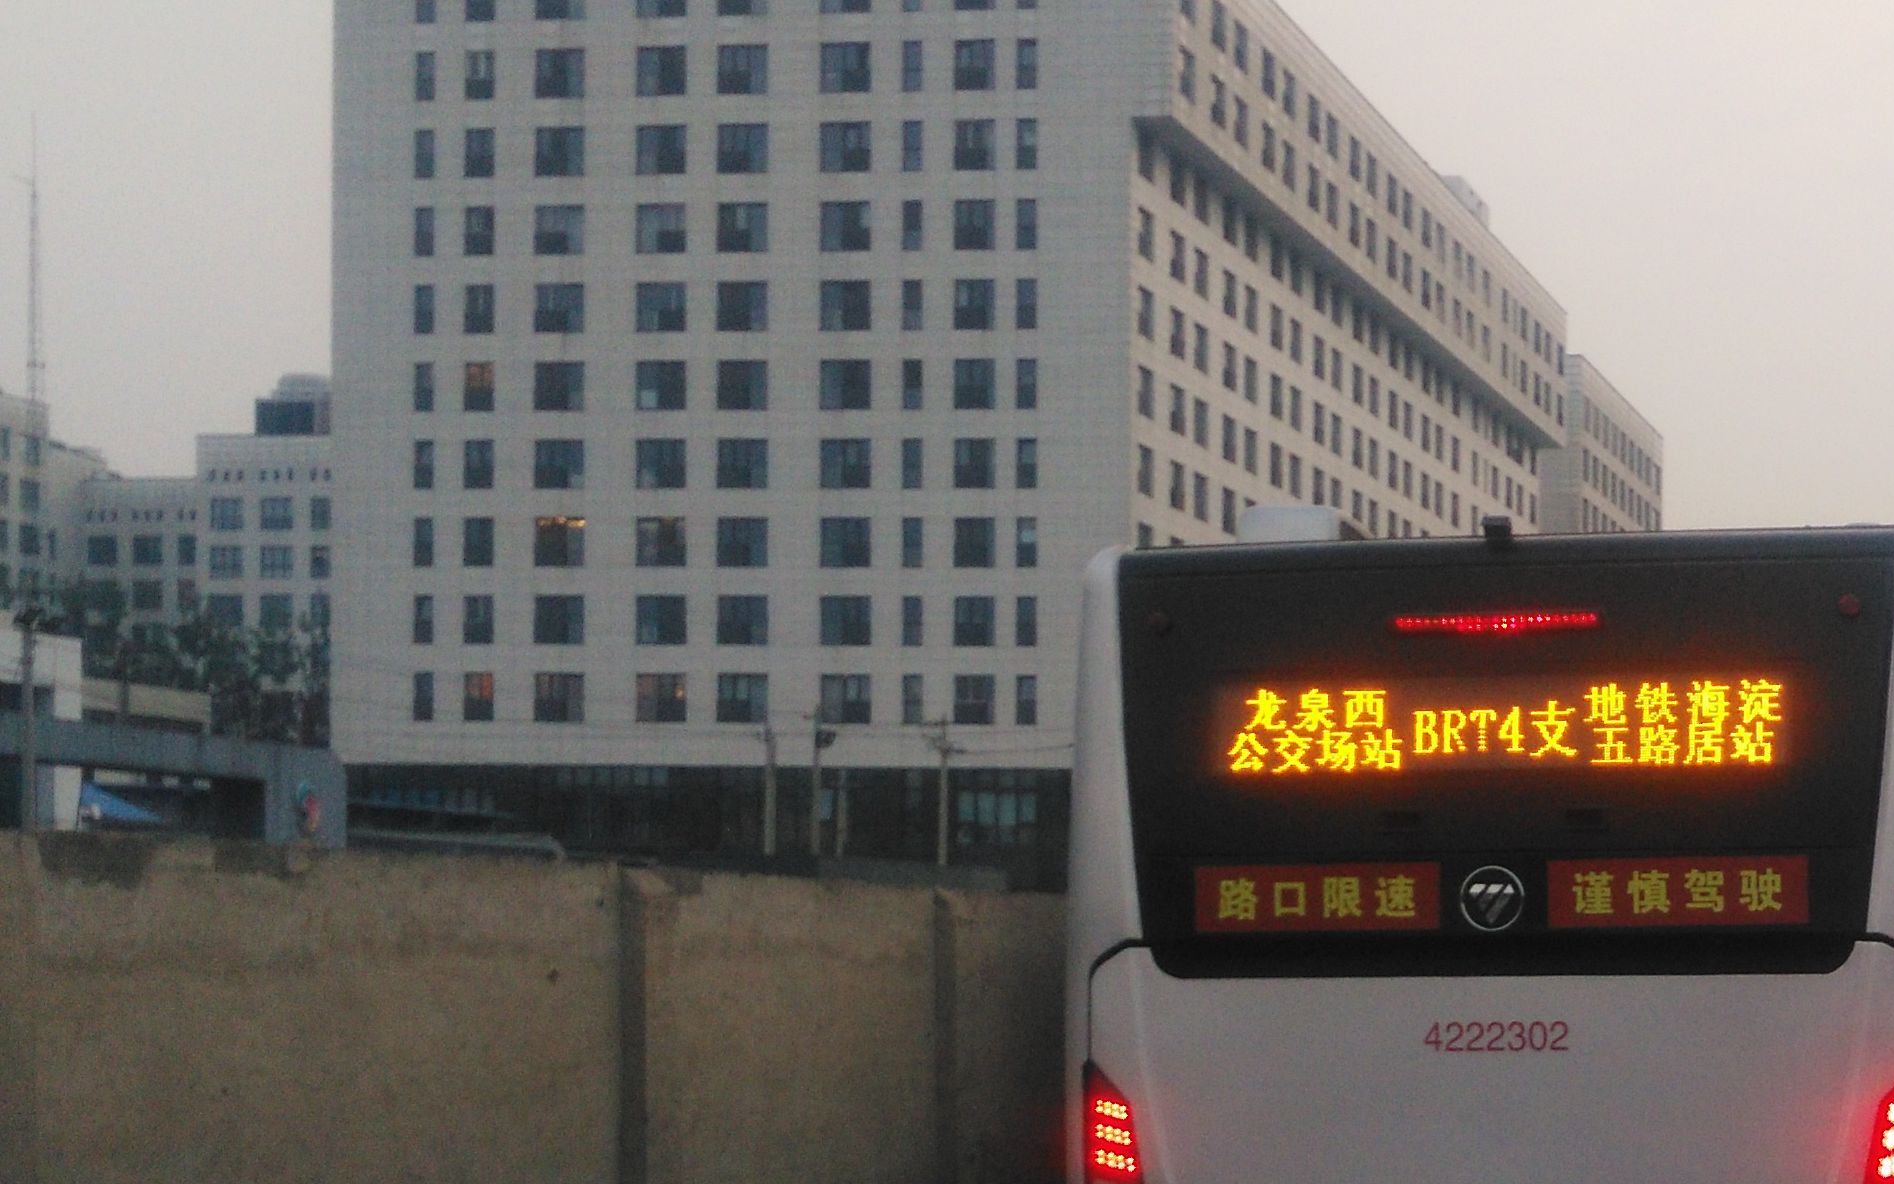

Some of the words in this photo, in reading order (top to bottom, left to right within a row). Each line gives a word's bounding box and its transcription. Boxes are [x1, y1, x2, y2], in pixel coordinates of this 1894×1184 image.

[1245, 688, 1387, 731] 龙泉西
[1583, 679, 1783, 726] 地铁海淀
[1228, 728, 1402, 773] 公交场站
[1412, 700, 1577, 758] BRT4支
[1590, 722, 1774, 766] 五路居站
[1218, 874, 1417, 921] 路口限速
[1573, 868, 1784, 915] 谨慎驾驶
[1424, 1020, 1570, 1052] 4222302
